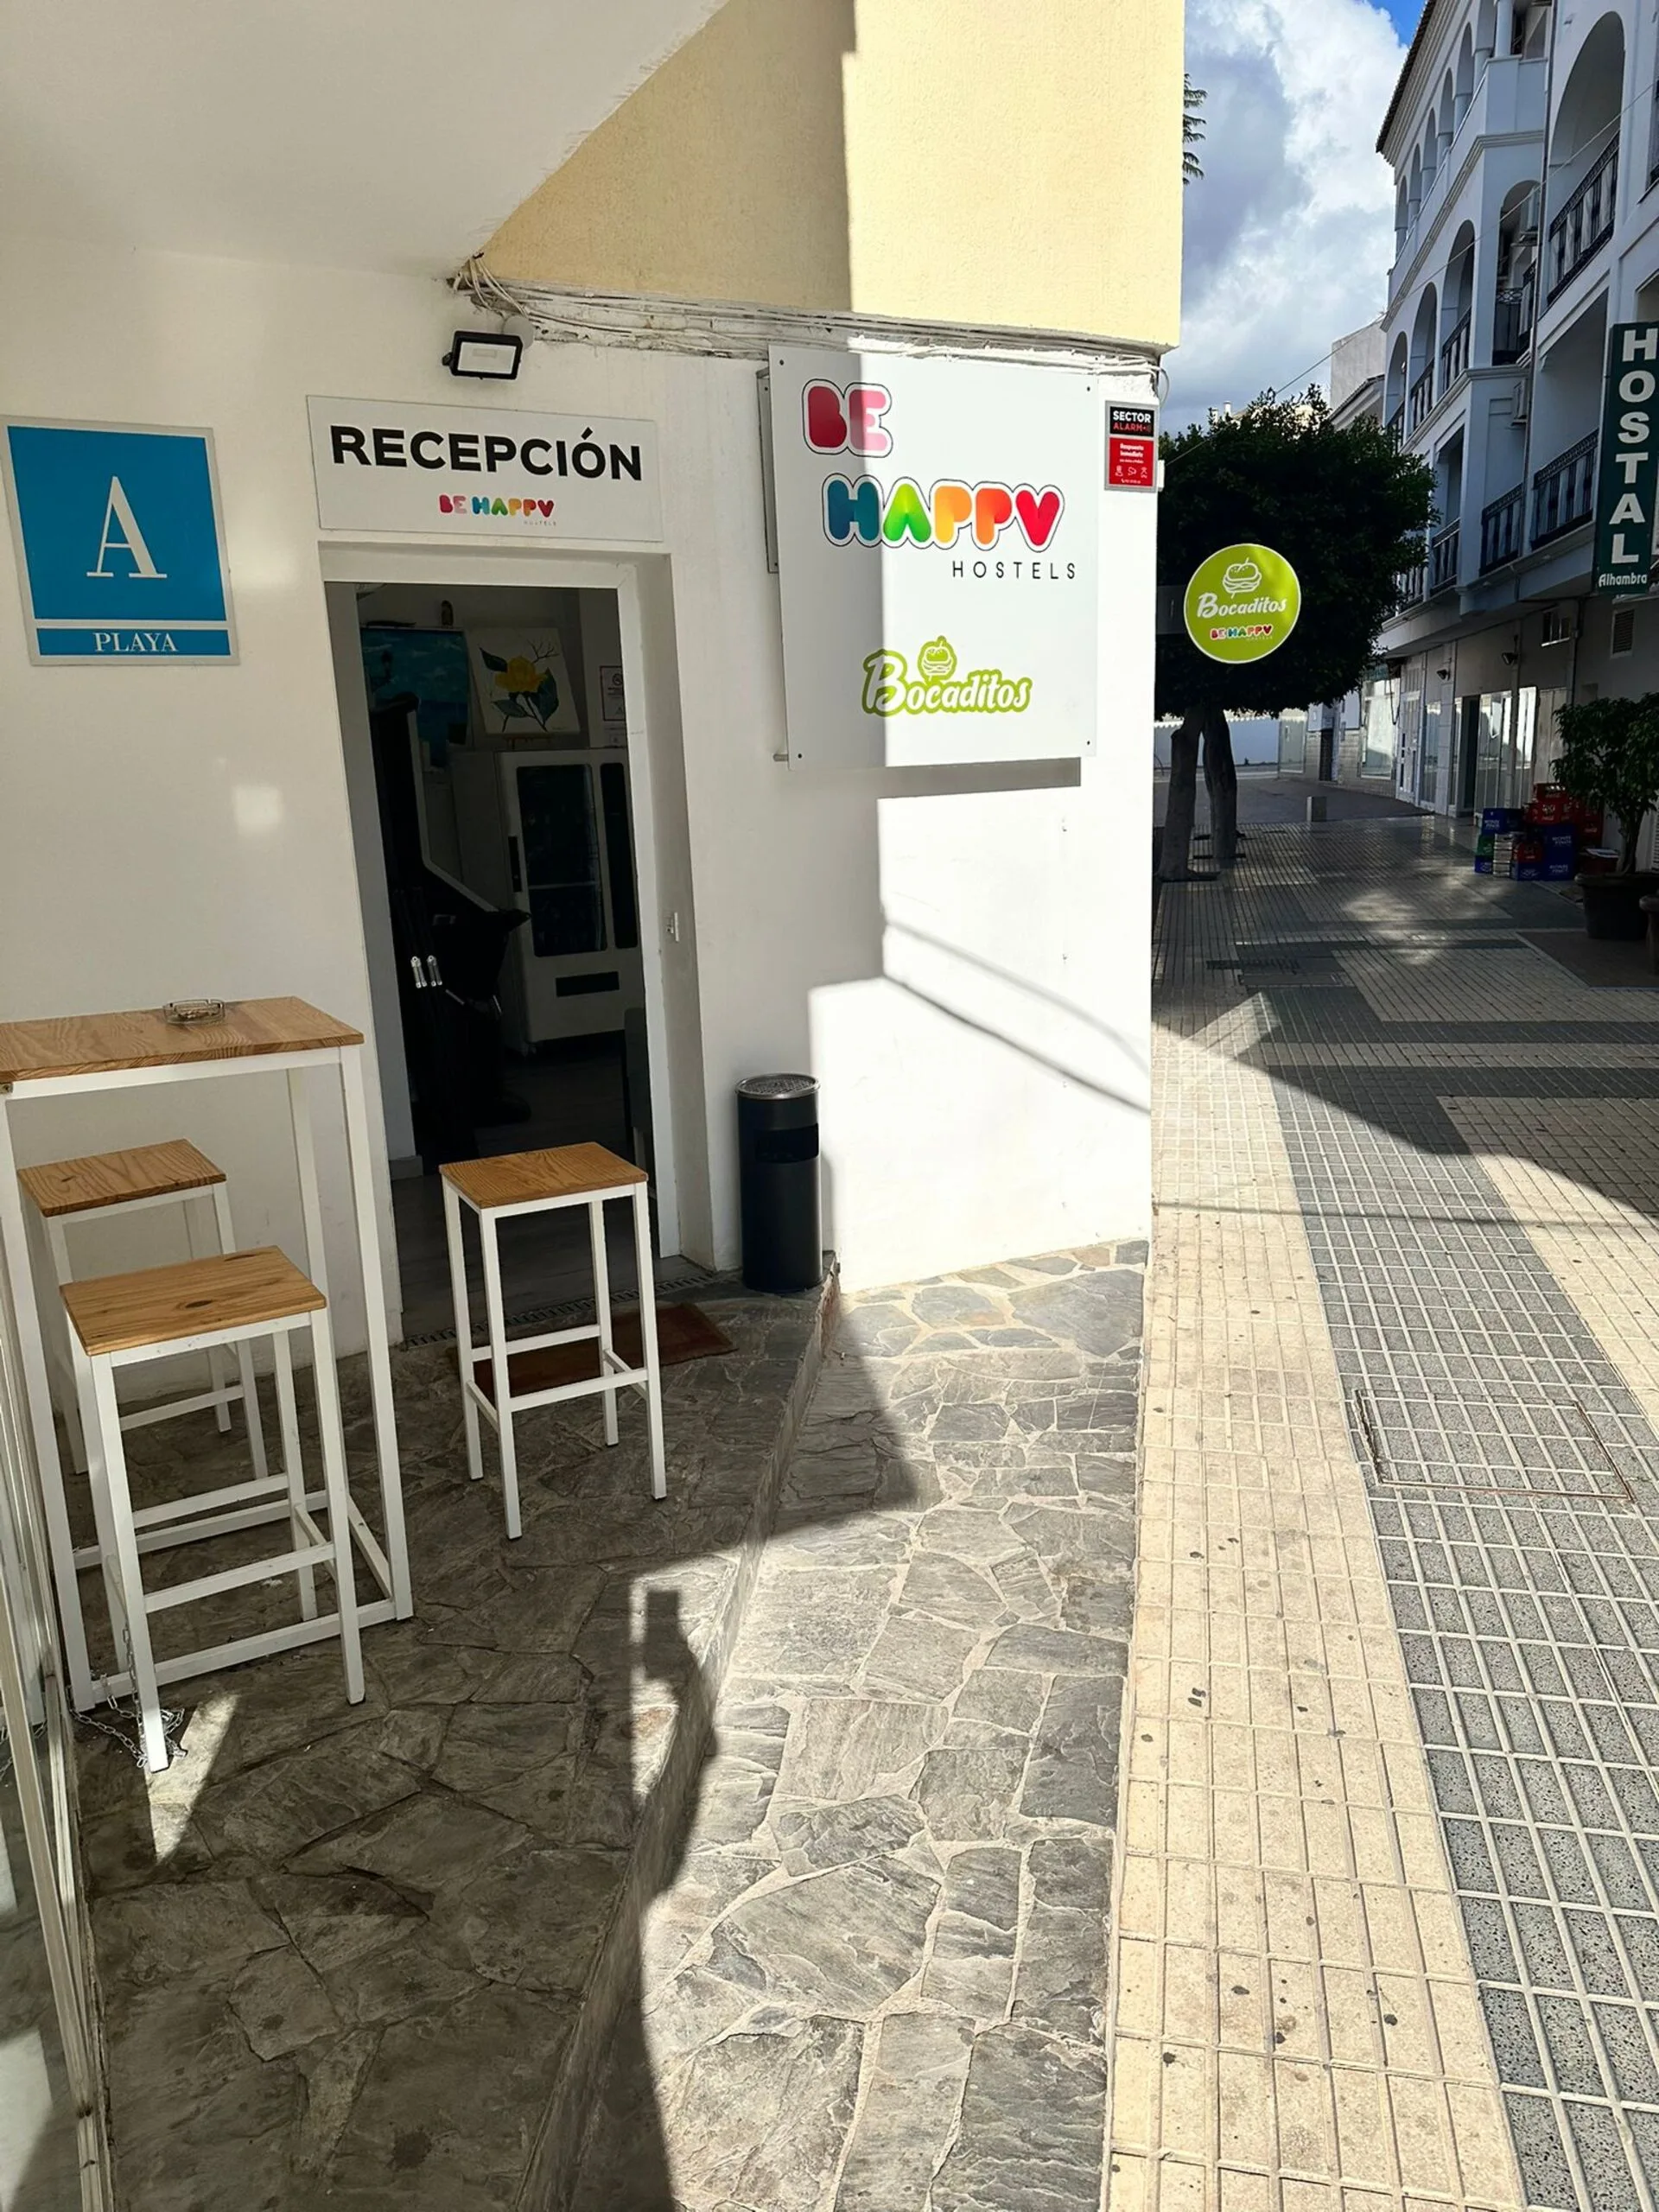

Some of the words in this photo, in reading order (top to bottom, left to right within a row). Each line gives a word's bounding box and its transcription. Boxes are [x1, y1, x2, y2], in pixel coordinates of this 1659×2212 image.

[804, 381, 891, 454] BE
[1113, 410, 1151, 423] SECTOR
[1113, 422, 1142, 432] ALARM
[330, 425, 642, 480] RECEPCIÓN
[1609, 327, 1658, 564] HOSTAL
[438, 493, 467, 515] BE
[86, 476, 168, 578] A
[951, 560, 1076, 581] HOSTELS
[1599, 572, 1648, 588] Alhambra
[1197, 592, 1287, 619] Bocaditos
[93, 632, 178, 652] PLAYA
[1211, 628, 1226, 640] BE
[864, 651, 1033, 715] Bocaditos
